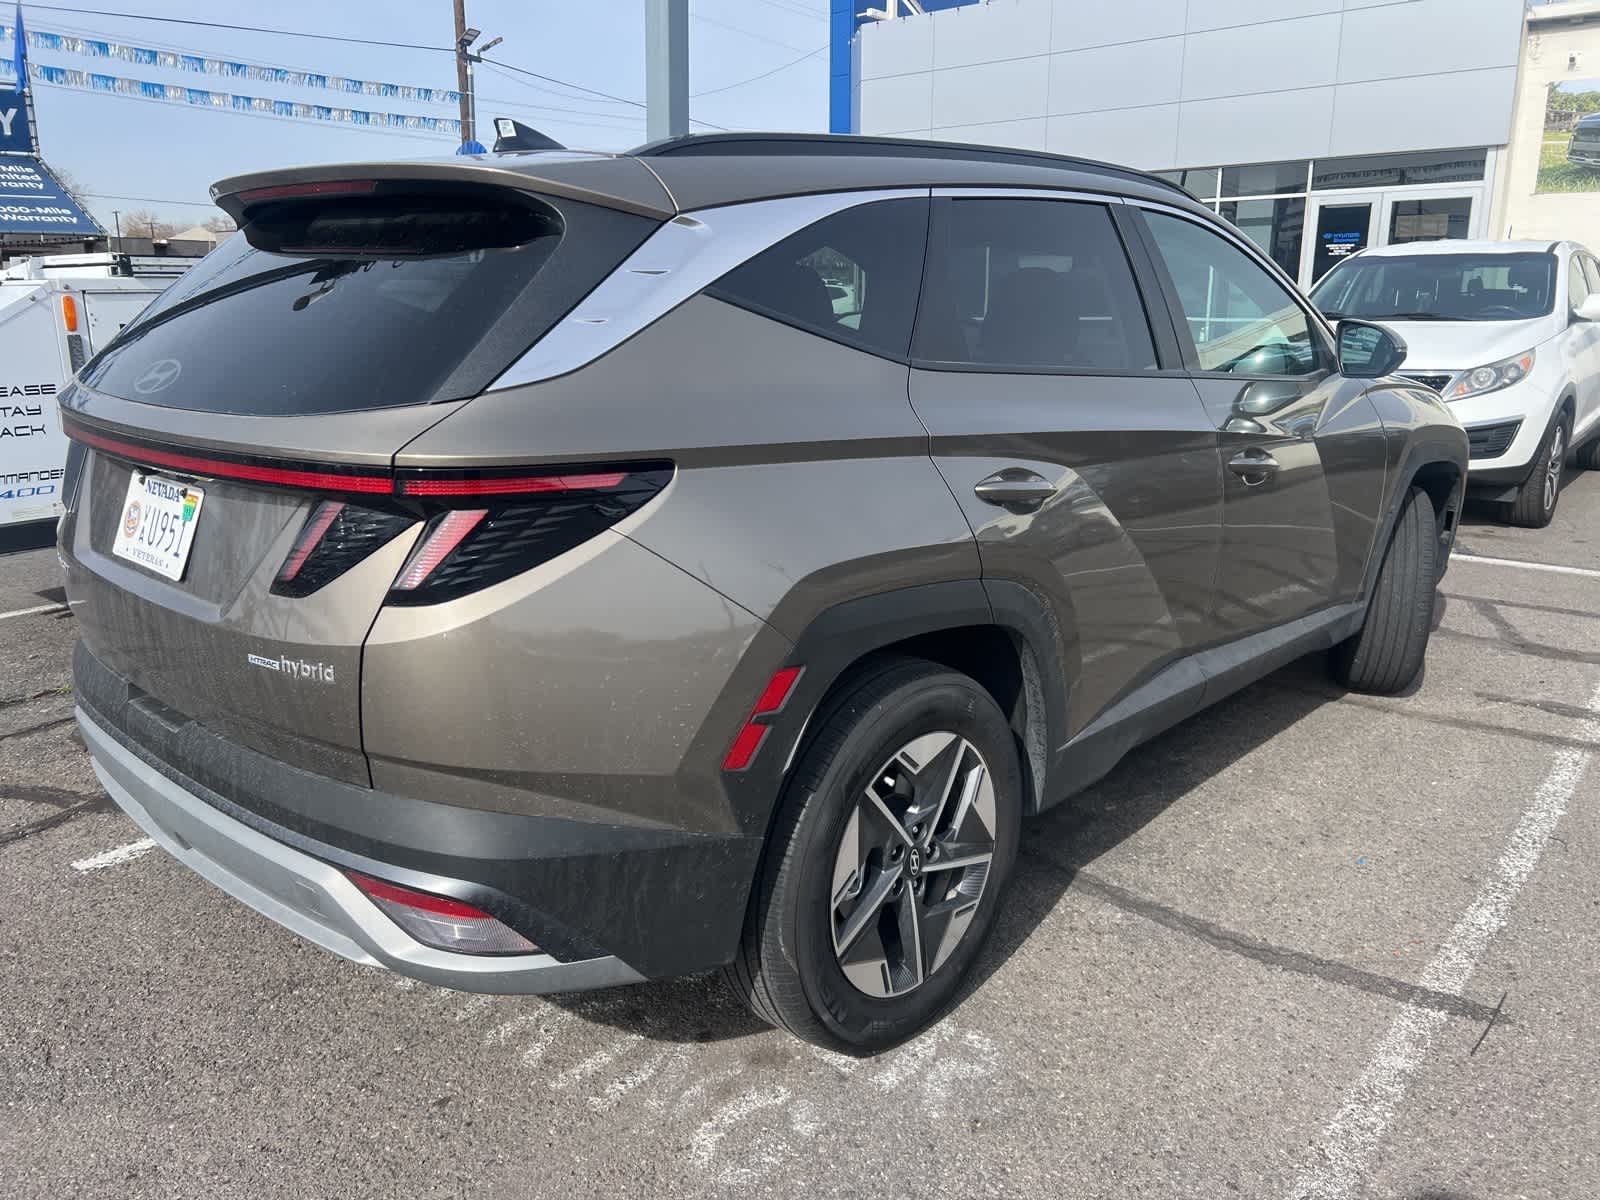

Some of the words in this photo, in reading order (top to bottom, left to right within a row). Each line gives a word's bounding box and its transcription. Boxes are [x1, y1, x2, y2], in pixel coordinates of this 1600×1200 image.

[0, 424, 46, 438] ACK
[145, 479, 180, 503] NEVADA
[281, 655, 335, 682] hybrid
